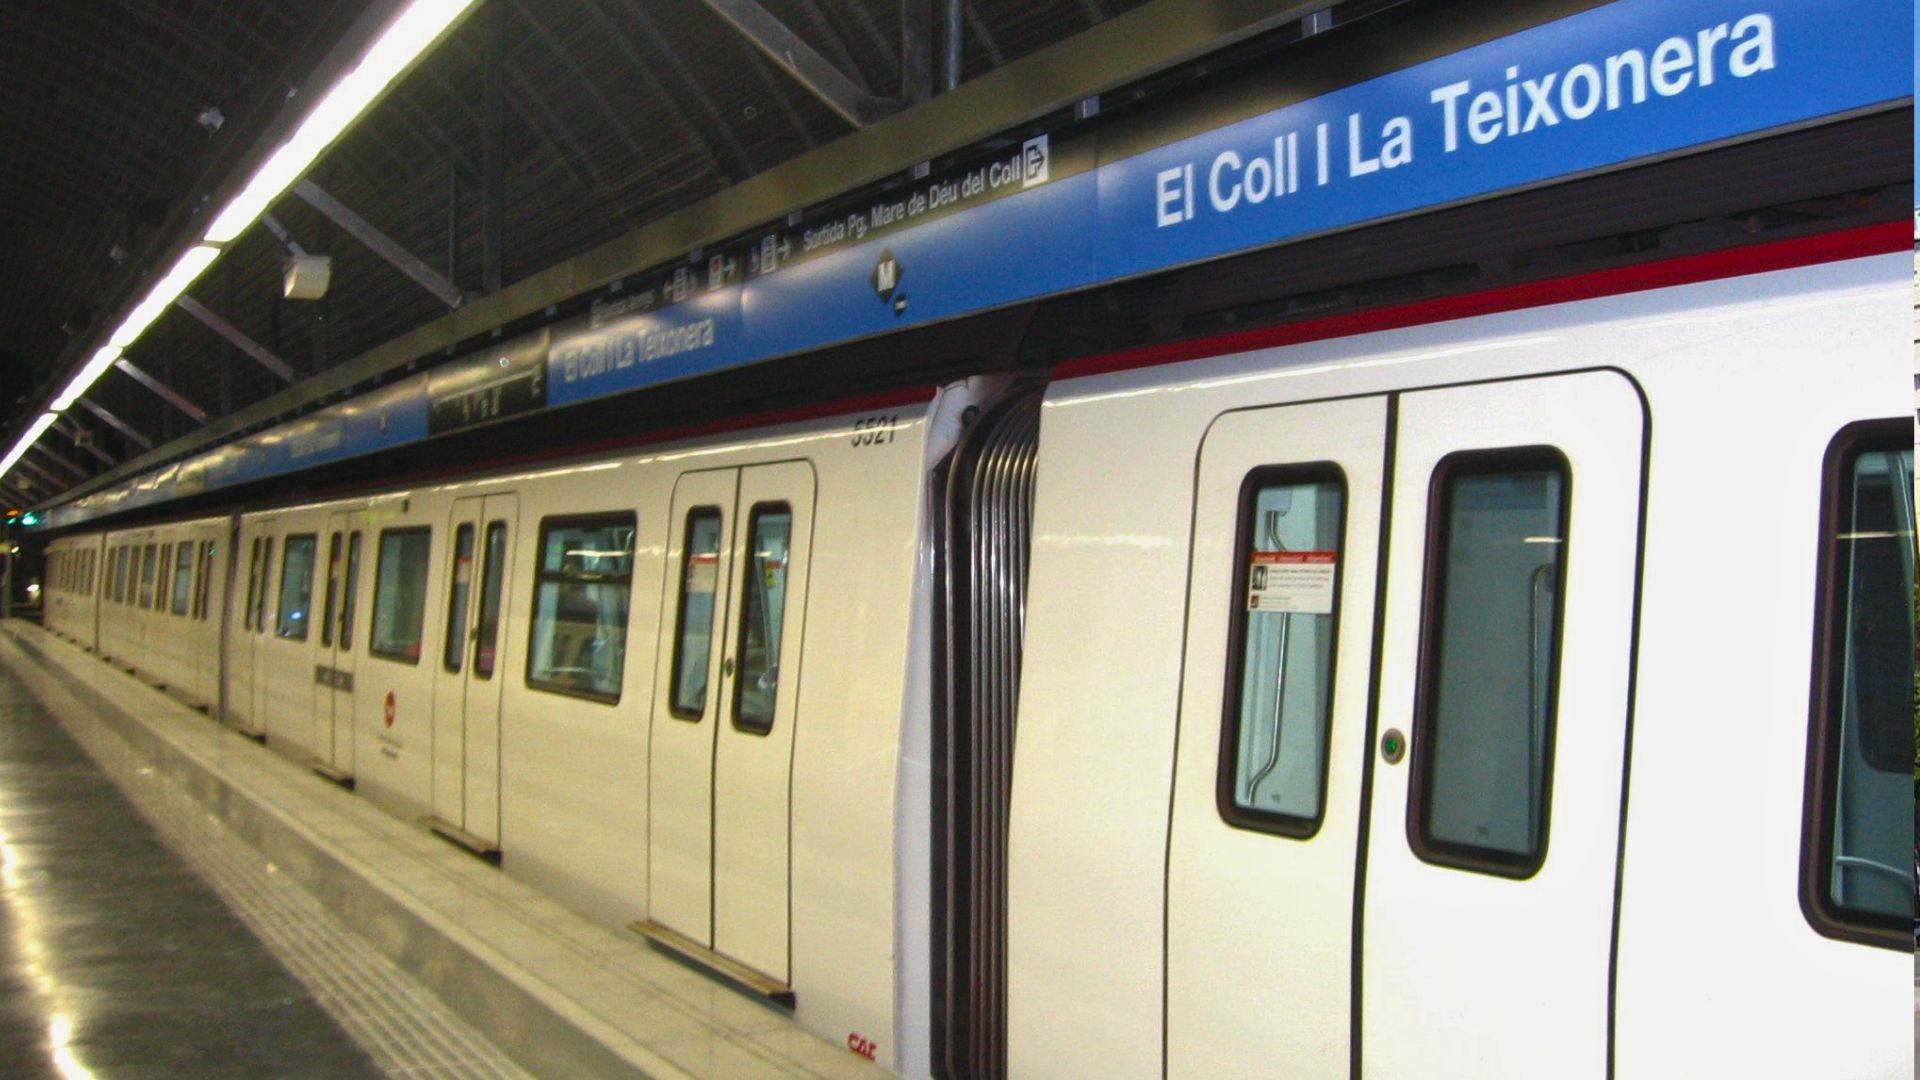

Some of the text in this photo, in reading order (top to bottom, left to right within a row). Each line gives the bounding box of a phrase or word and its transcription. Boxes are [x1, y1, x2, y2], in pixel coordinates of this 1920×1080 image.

[1157, 163, 1194, 227] El
[1209, 132, 1298, 212] Coll
[1349, 112, 1412, 177] La
[1430, 12, 1776, 153] Teixonera
[803, 222, 845, 251] Sortida
[871, 203, 904, 228] Mare
[907, 192, 925, 215] de
[929, 179, 958, 209] Déu
[962, 167, 985, 198] del
[989, 155, 1020, 188] Coll
[878, 259, 895, 292] M
[851, 415, 898, 448] 5521
